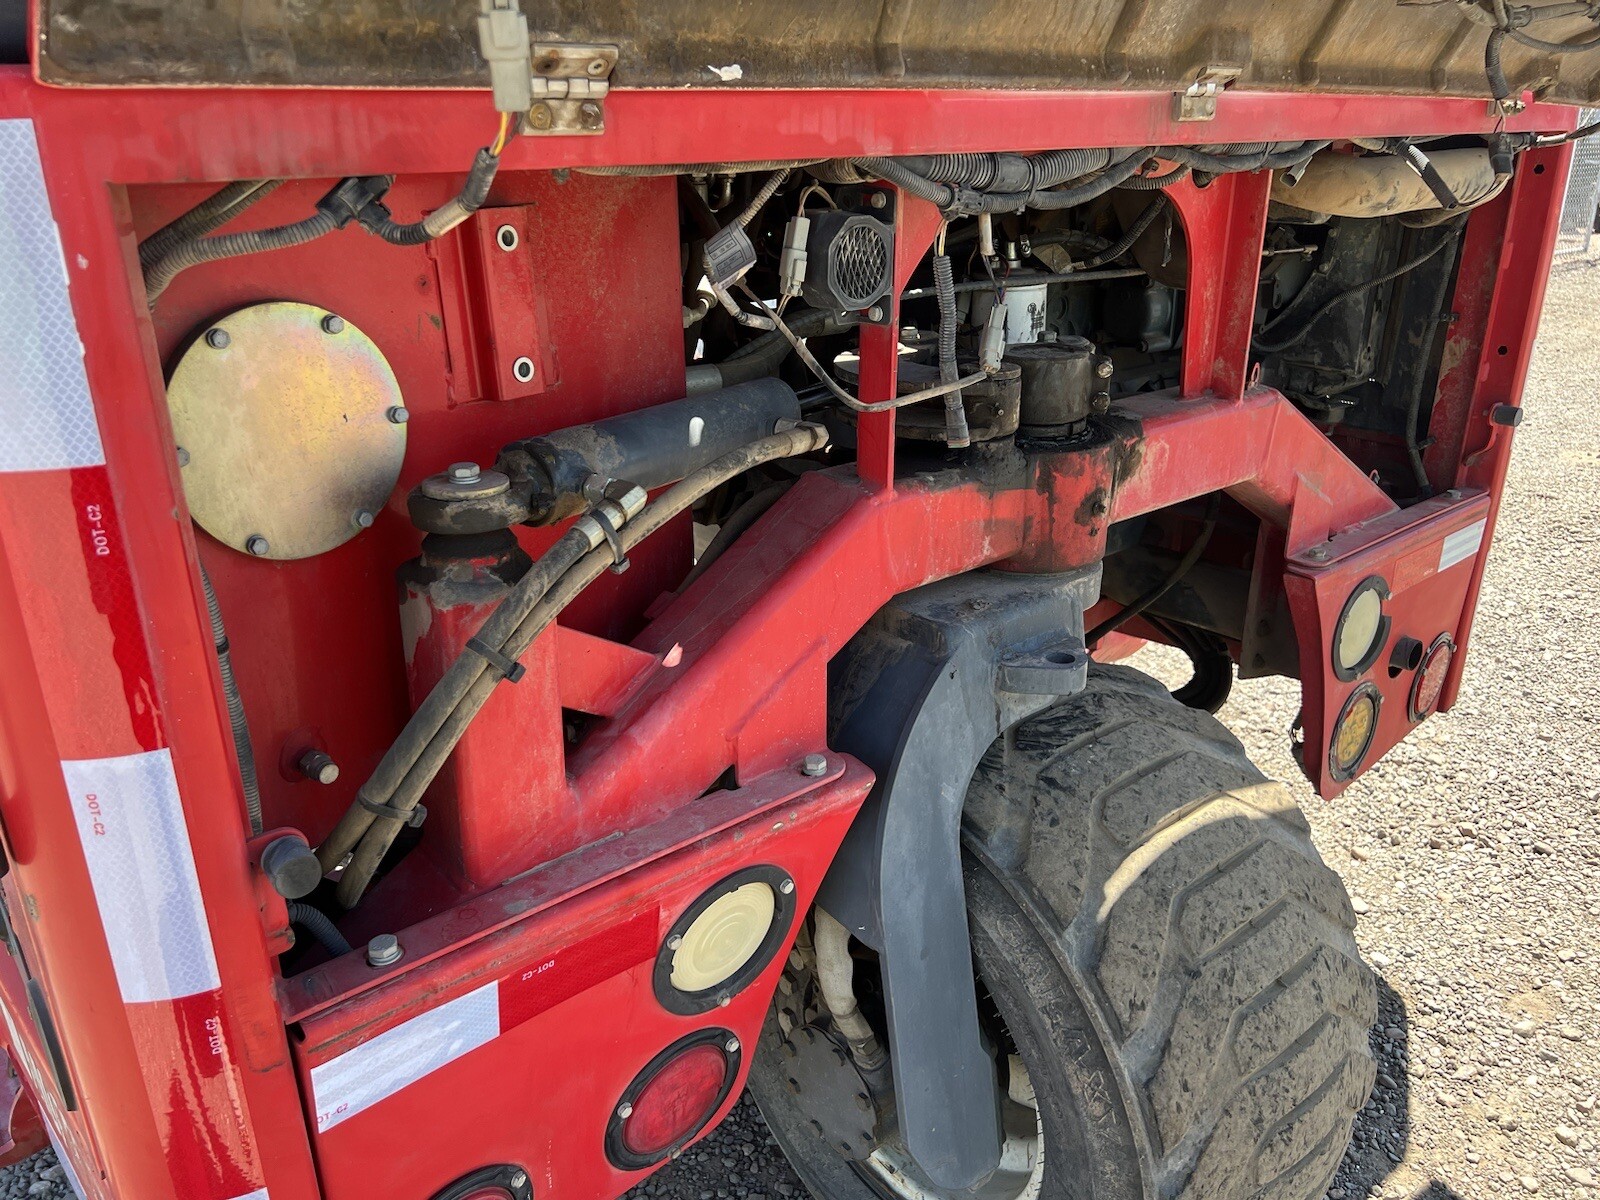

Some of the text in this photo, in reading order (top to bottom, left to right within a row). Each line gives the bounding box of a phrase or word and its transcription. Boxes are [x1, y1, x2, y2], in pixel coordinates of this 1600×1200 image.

[86, 503, 110, 556] DOT-C2
[85, 793, 106, 836] DOT-C2
[522, 959, 555, 981] DOT-C2
[204, 1016, 222, 1055] DOT-C2
[316, 1102, 349, 1124] OT-C2
